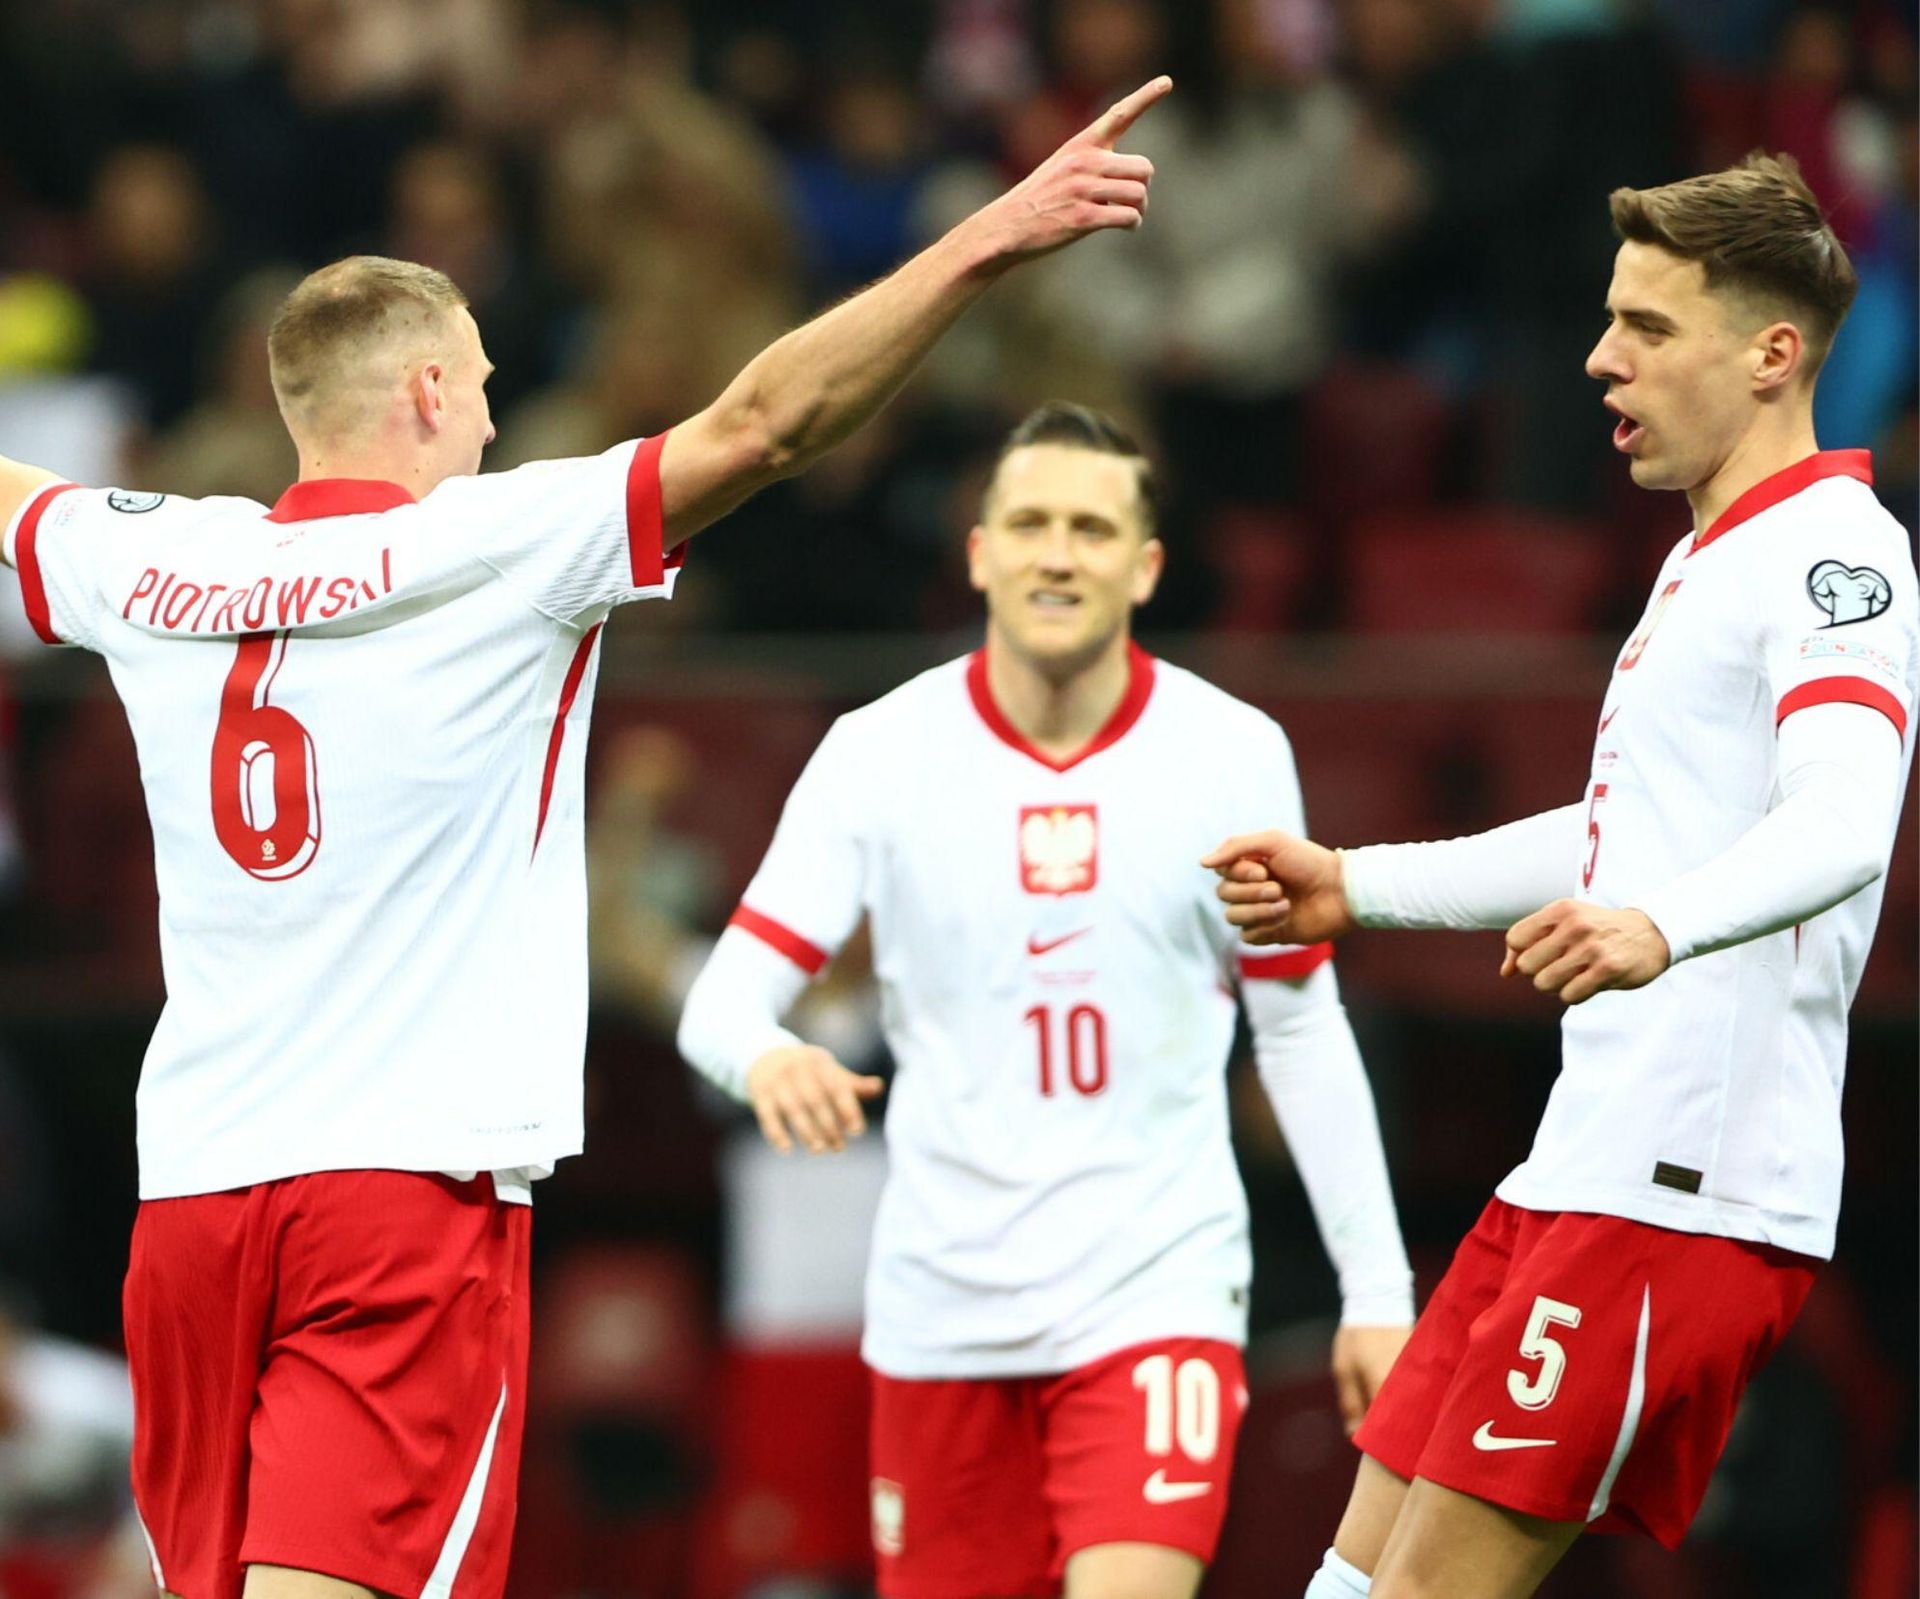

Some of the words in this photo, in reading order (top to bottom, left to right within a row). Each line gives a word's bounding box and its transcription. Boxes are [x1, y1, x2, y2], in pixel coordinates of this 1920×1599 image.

[210, 629, 321, 882] 6
[1583, 783, 1609, 893] 5
[1023, 1003, 1109, 1099] 10
[1506, 1295, 1583, 1412] 5
[1132, 1354, 1220, 1464] 10
